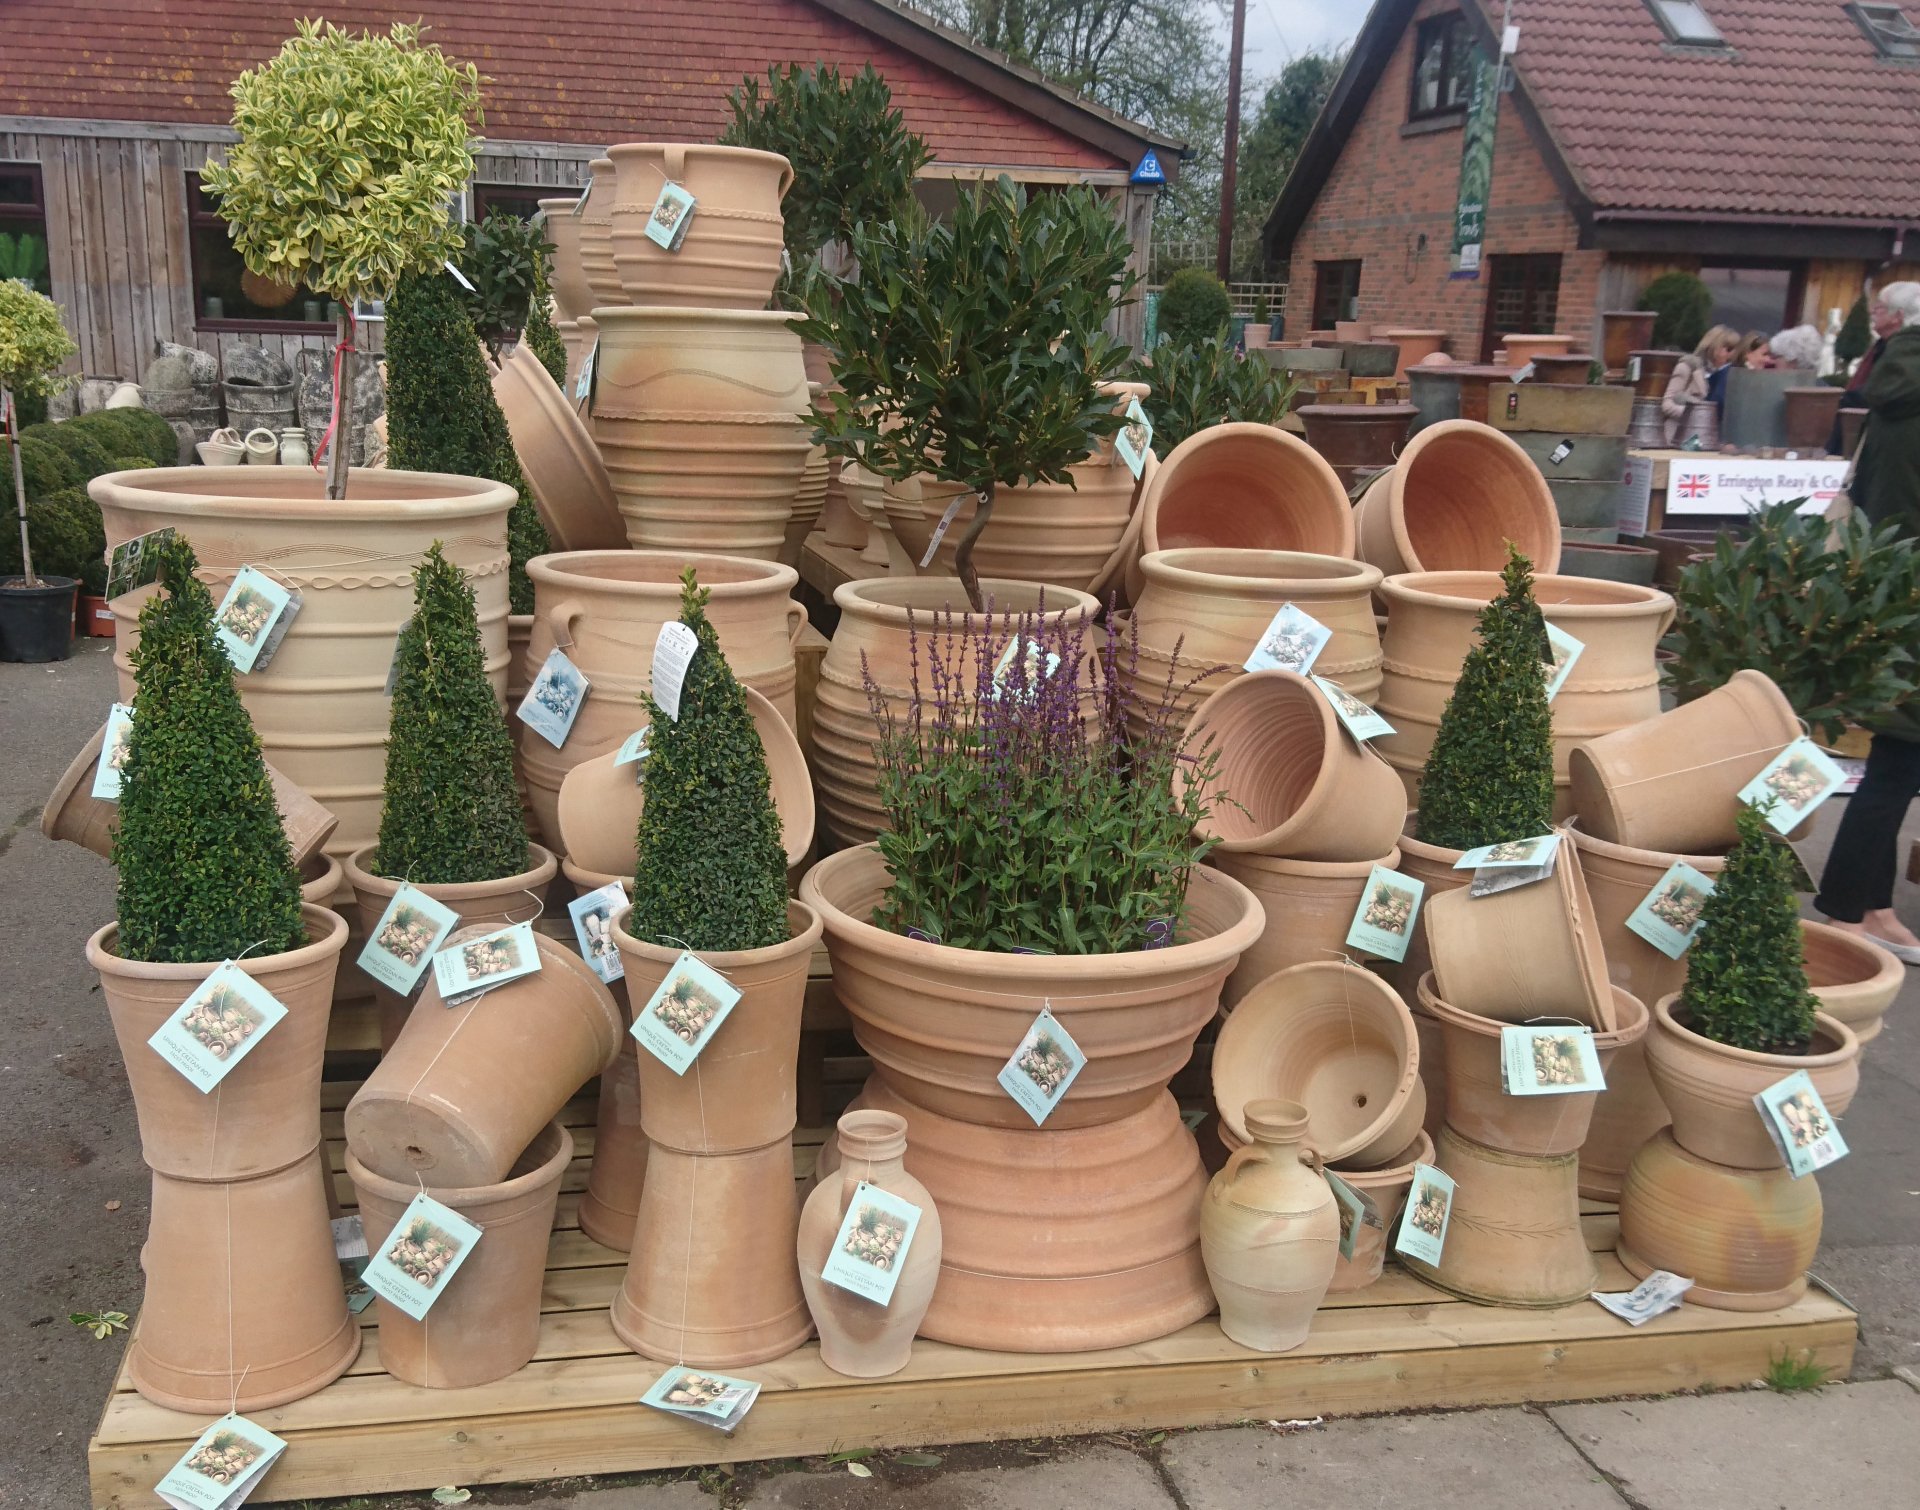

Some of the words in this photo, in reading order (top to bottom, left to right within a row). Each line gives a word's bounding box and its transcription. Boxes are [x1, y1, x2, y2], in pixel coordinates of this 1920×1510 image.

[1139, 170, 1160, 178] Chubb
[1717, 473, 1774, 492] Errington
[1776, 474, 1806, 492] Reay
[1809, 475, 1820, 489] &
